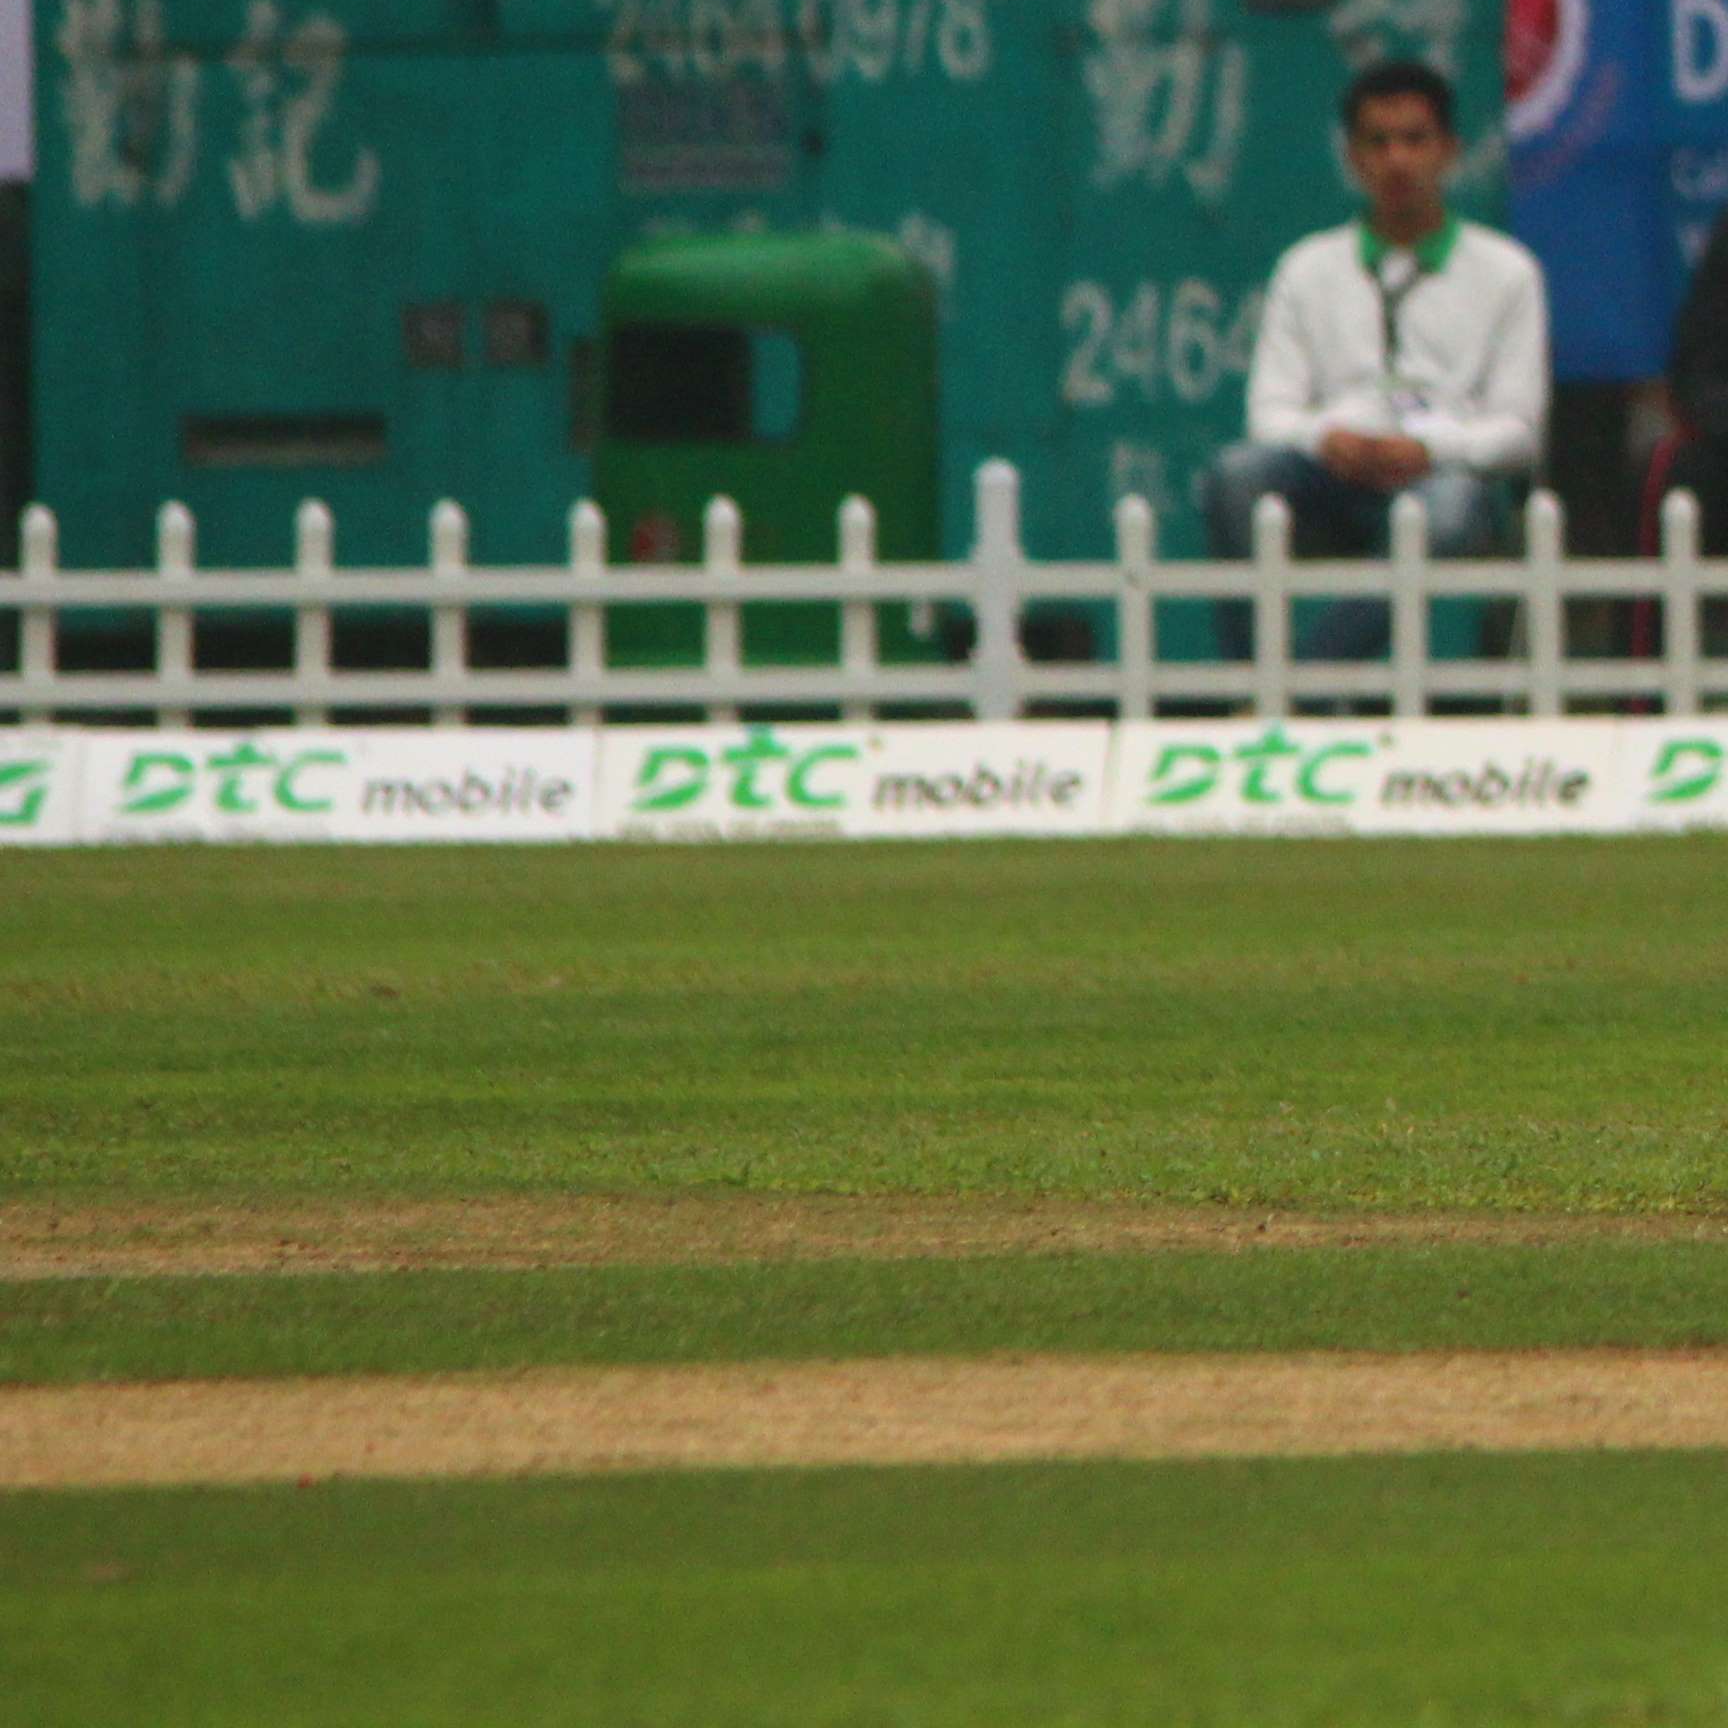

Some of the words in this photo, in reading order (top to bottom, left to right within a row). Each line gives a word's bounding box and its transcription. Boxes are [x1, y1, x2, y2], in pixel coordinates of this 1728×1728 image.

[362, 763, 574, 819] mobile
[872, 759, 1083, 810] mobile
[1382, 757, 1591, 808] mobile
